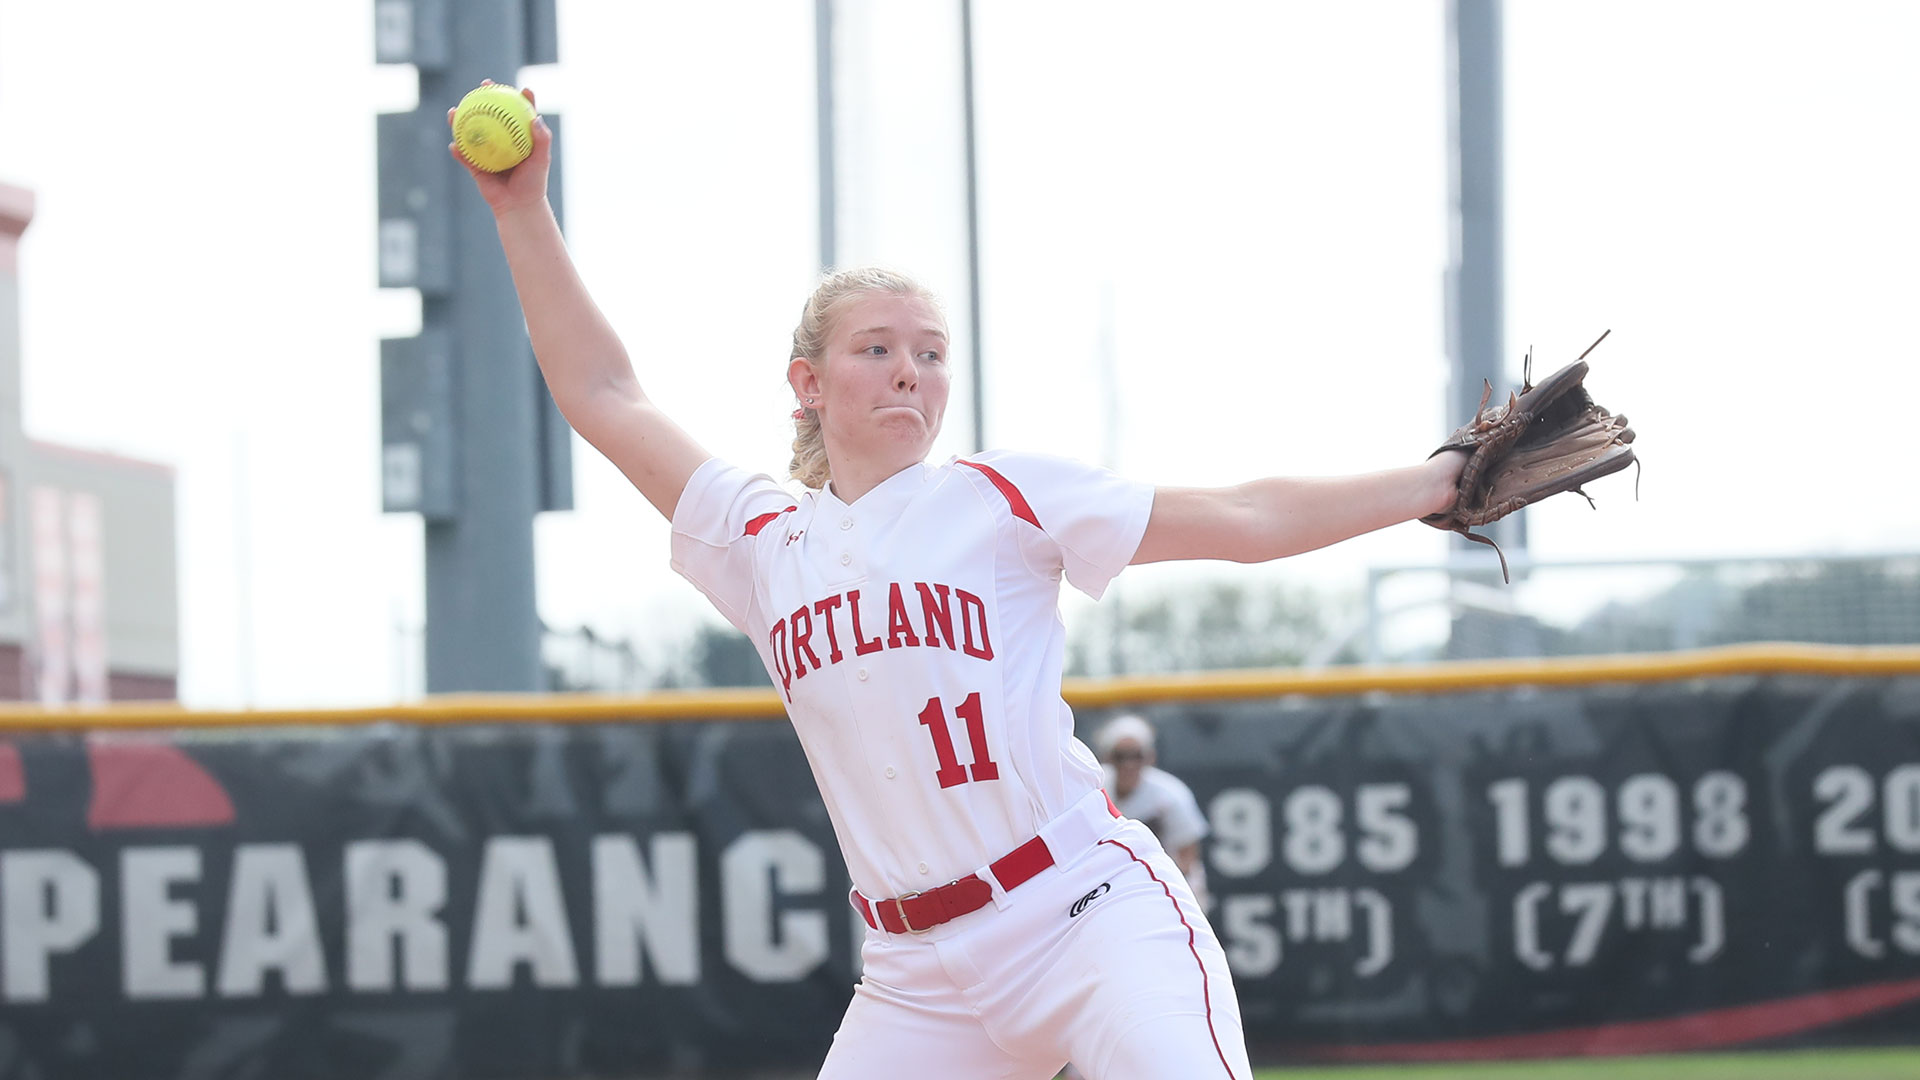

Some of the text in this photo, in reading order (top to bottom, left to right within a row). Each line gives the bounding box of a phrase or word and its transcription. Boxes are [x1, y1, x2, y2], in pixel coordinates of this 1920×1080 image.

[770, 582, 994, 704] ORTLAND
[918, 692, 999, 788] 11
[1208, 785, 1418, 877] 985
[1487, 770, 1749, 867] 1998
[2, 830, 866, 1003] PEARANC
[1210, 887, 1393, 977] 5TH)
[1513, 876, 1726, 970] (7TH)
